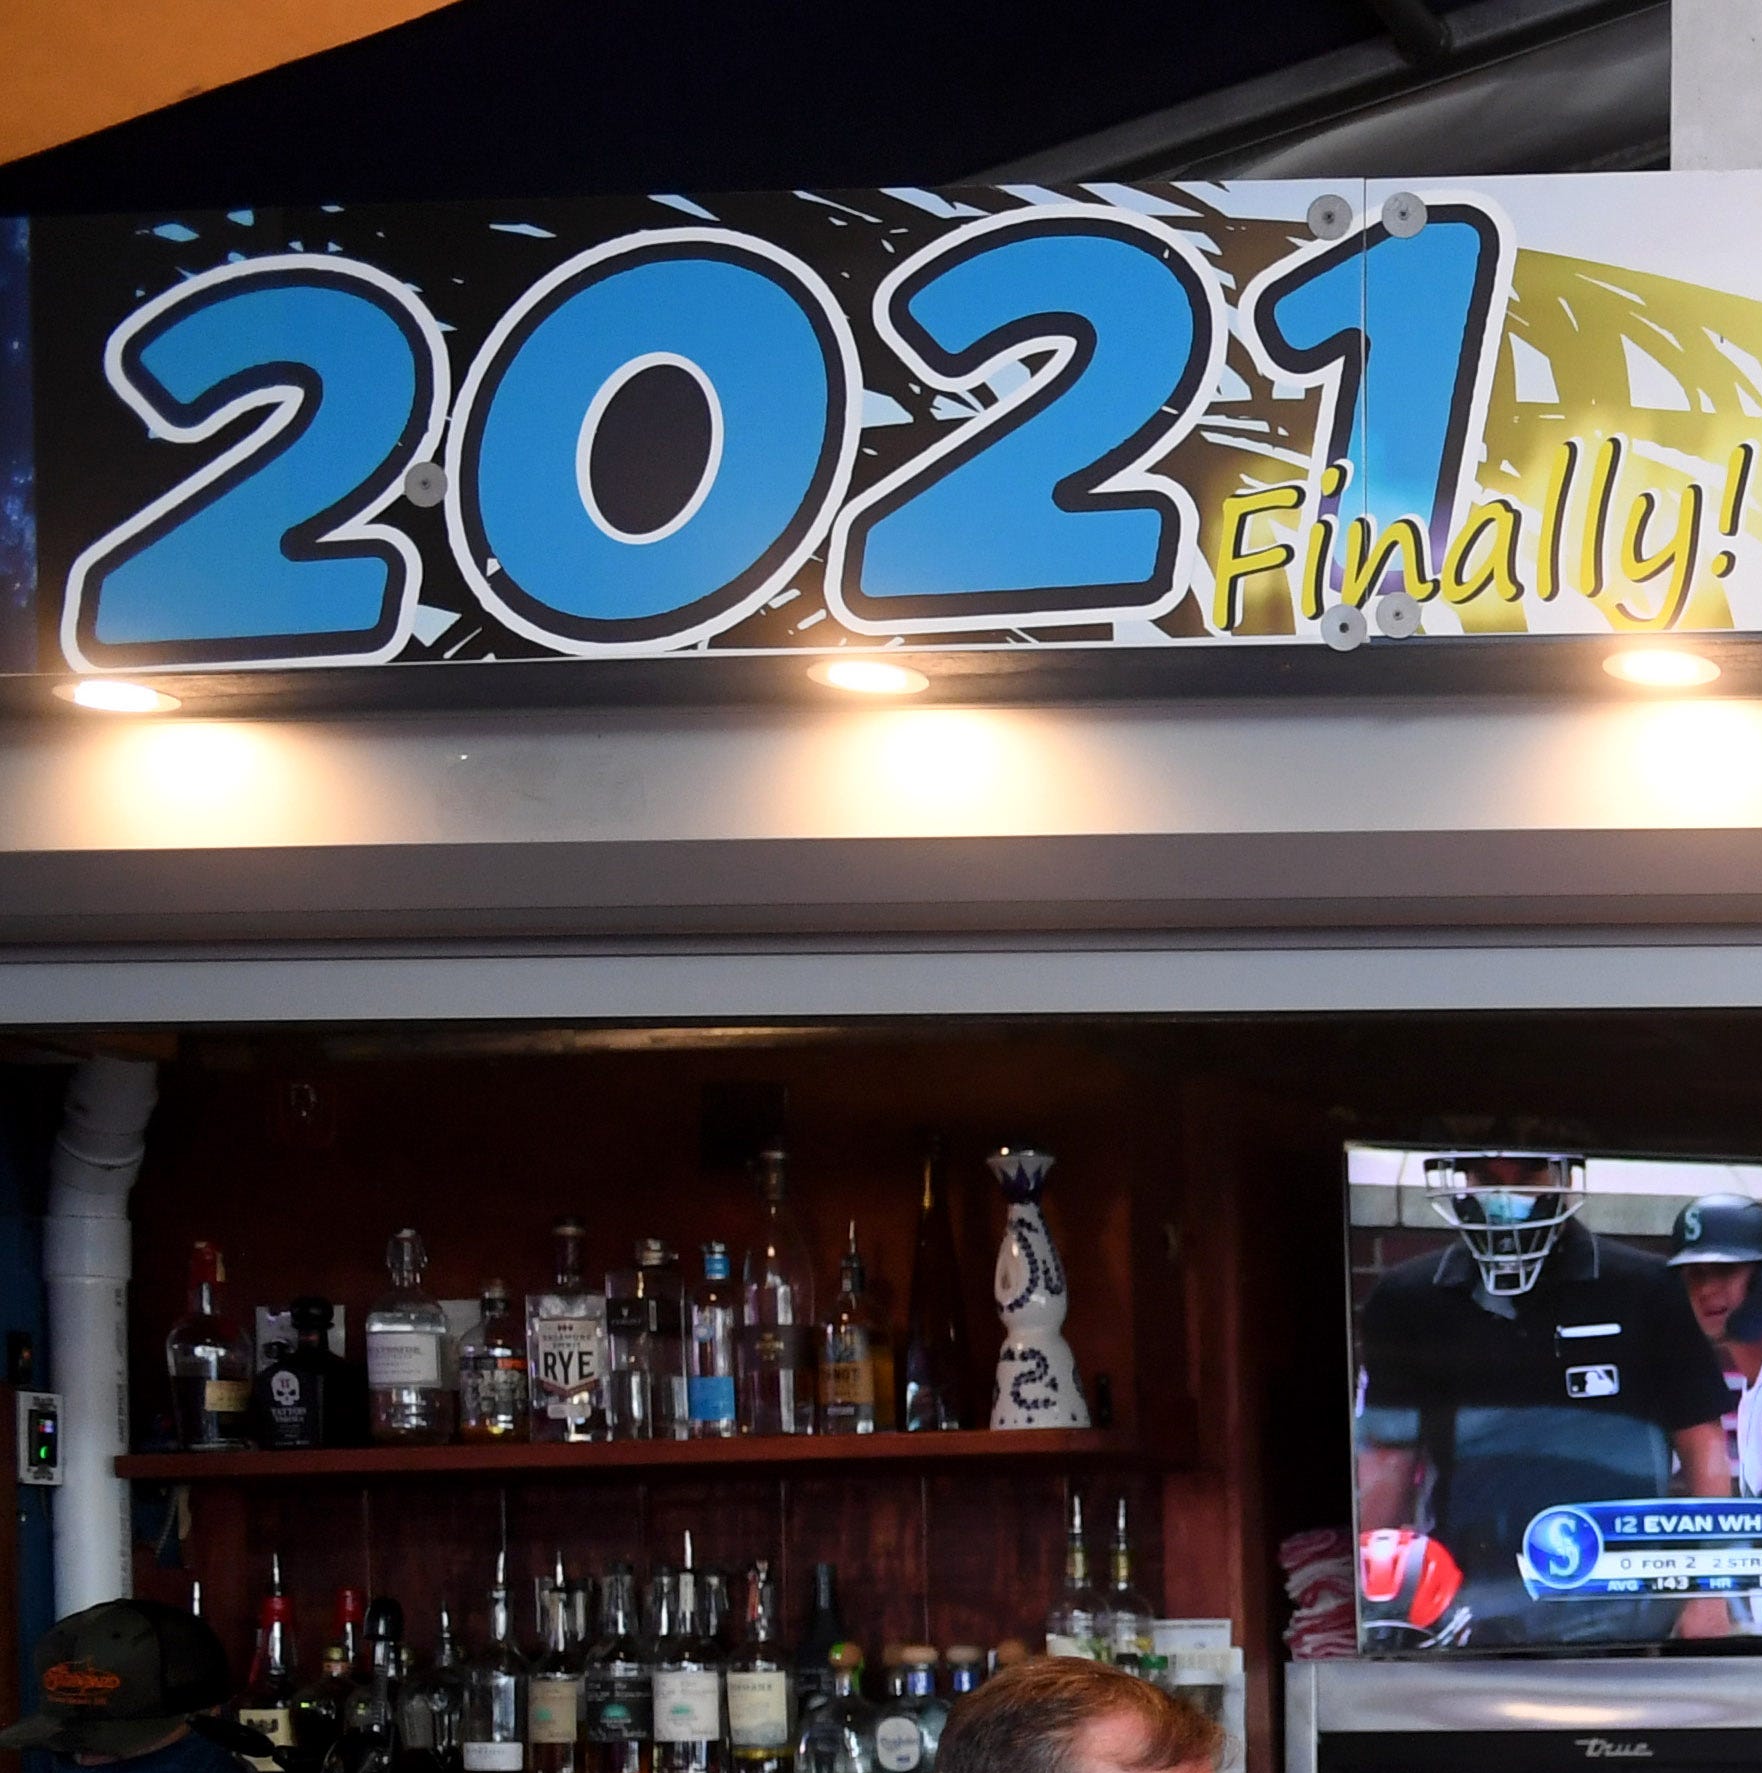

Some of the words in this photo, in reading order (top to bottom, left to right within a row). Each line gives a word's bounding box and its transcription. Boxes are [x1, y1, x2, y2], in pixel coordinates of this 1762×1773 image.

[60, 202, 1519, 674] 2021
[1212, 433, 1755, 632] Finally!
[543, 1351, 594, 1385] RYE
[1614, 1516, 1637, 1534] 12
[1644, 1515, 1712, 1533] EVAN
[1642, 1558, 1677, 1570] FOR
[1686, 1557, 1697, 1569] 2
[1607, 1579, 1638, 1592] AVG
[1651, 1575, 1689, 1591] .143
[1709, 1577, 1733, 1589] HR
[1575, 1738, 1653, 1757] True
